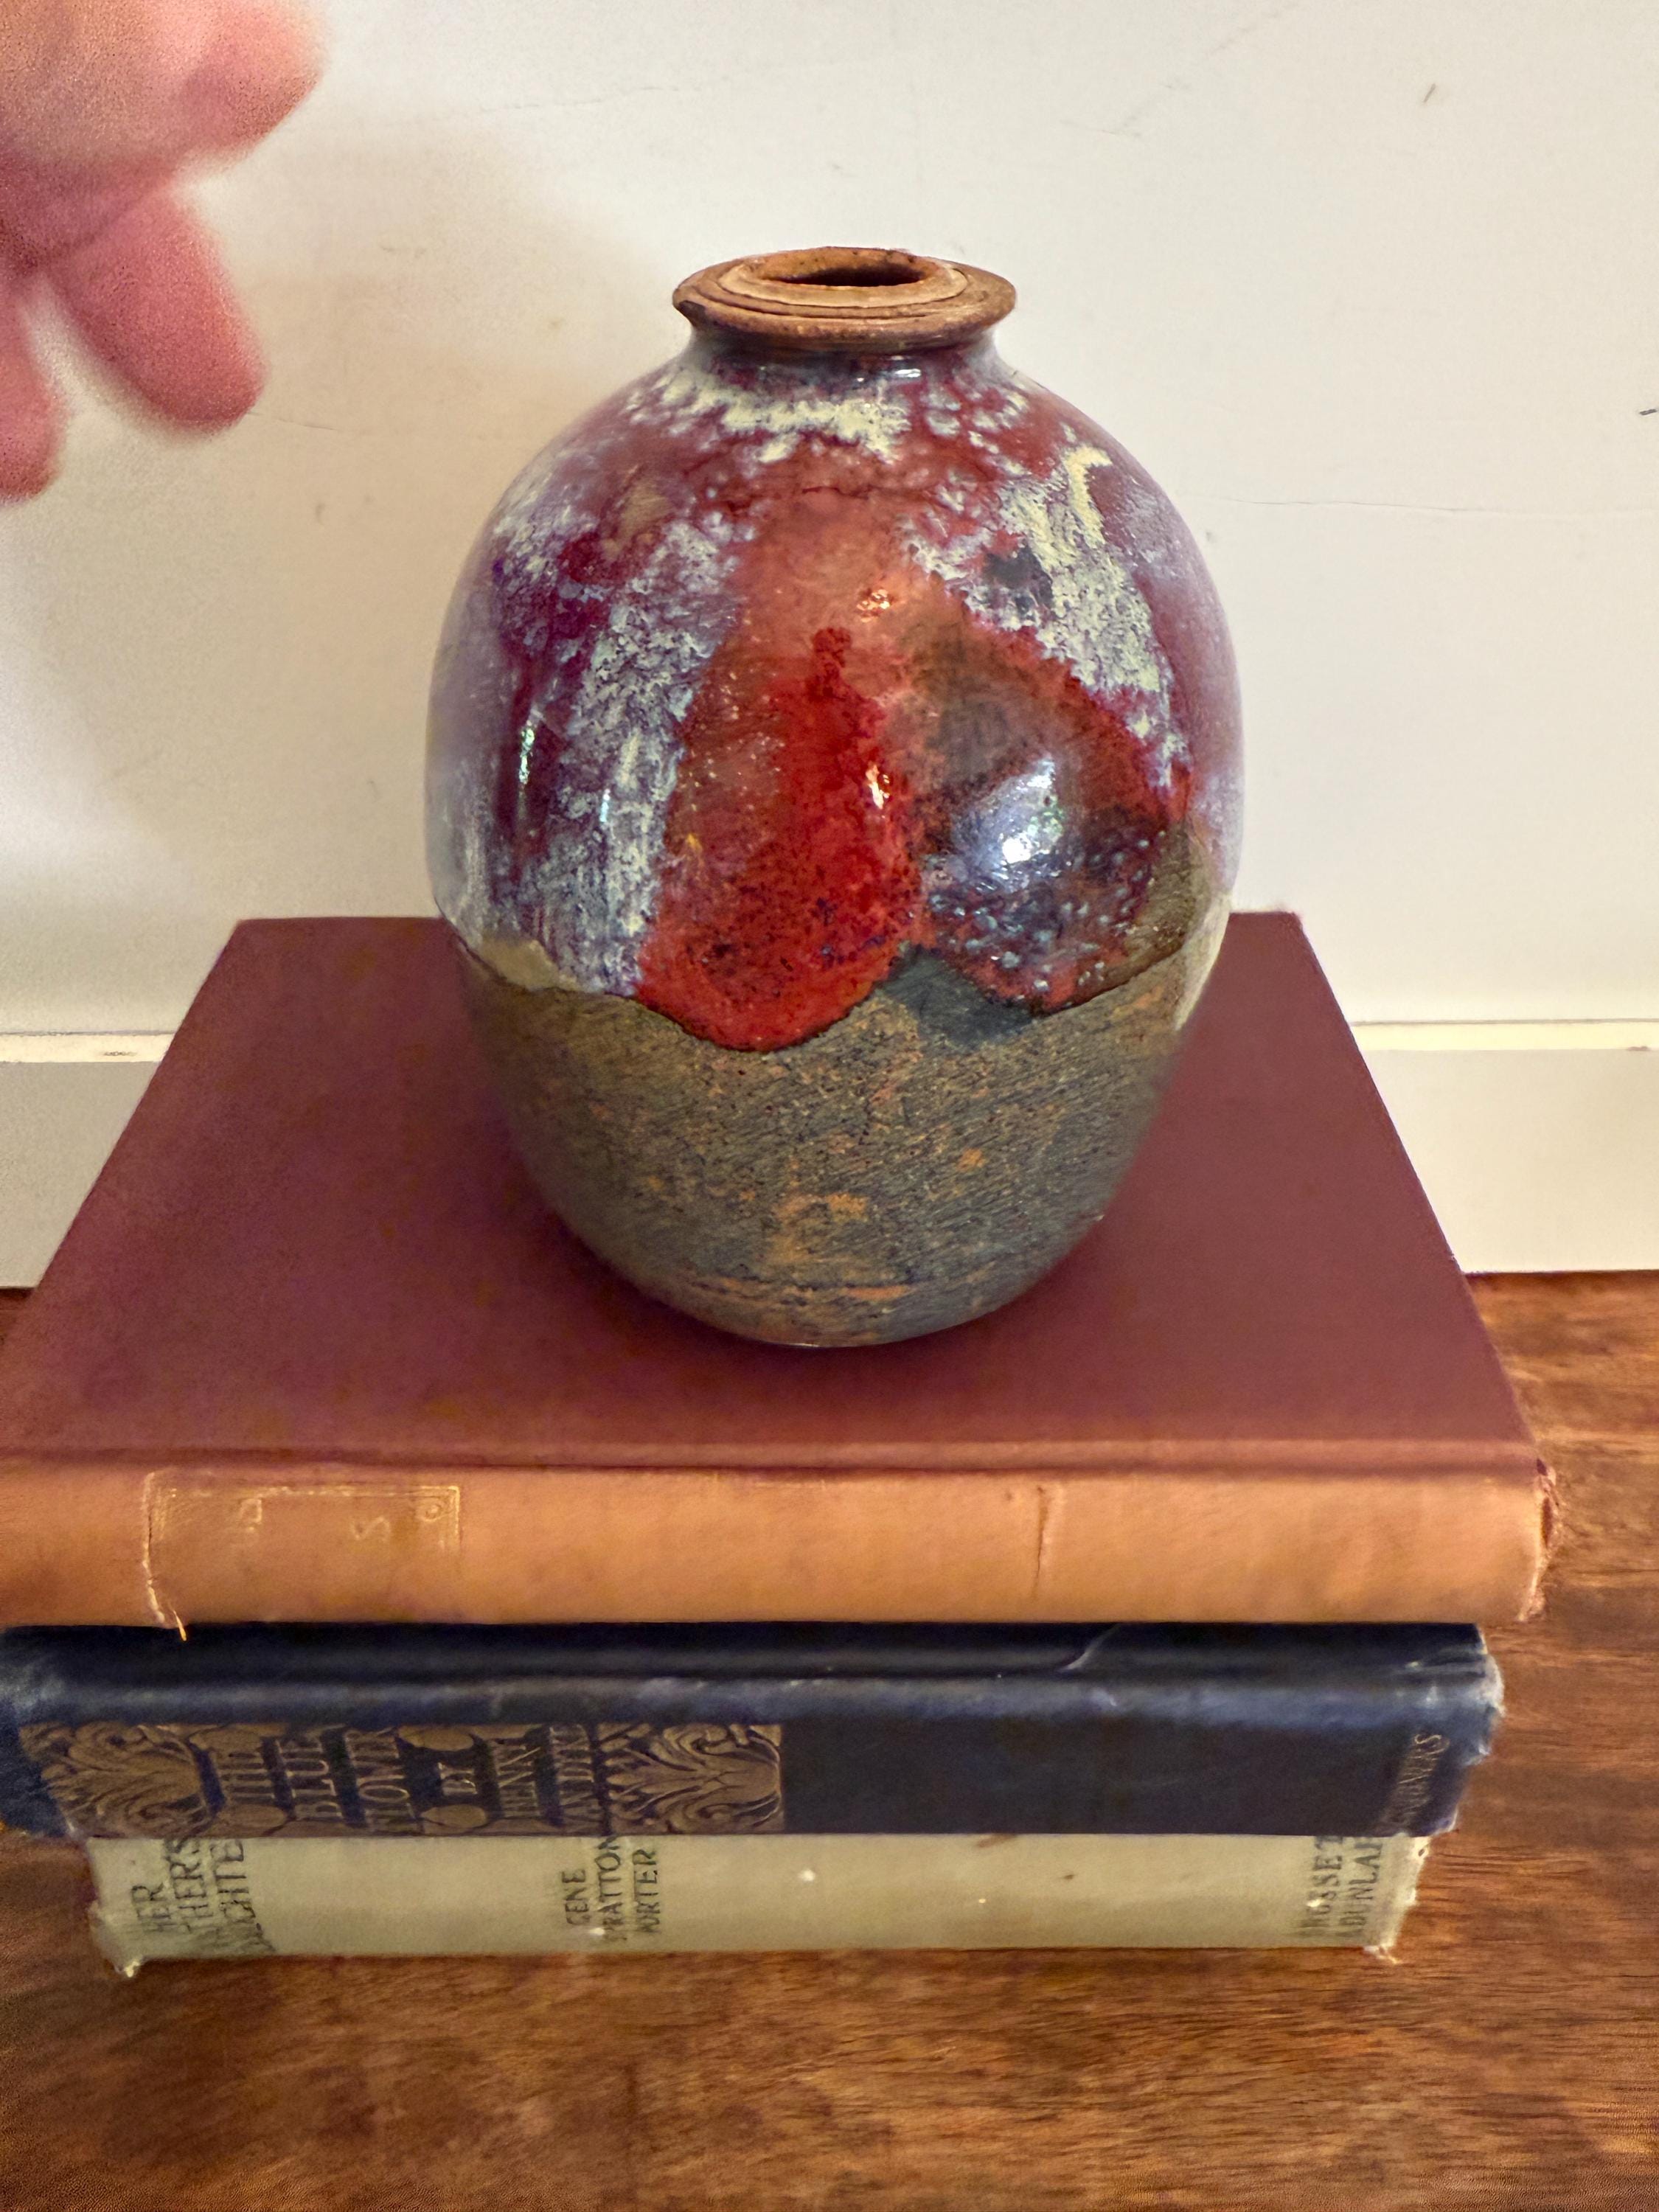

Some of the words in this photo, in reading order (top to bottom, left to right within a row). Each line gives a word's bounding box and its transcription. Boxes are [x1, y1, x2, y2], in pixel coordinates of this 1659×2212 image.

[213, 1751, 275, 1804] THE
[277, 1739, 344, 1820] BLUE
[344, 1728, 417, 1832] FLOWER
[437, 1762, 478, 1796] BY
[490, 1740, 543, 1818] HENRY
[131, 1882, 174, 1933] HER
[561, 1869, 591, 1926] GENE
